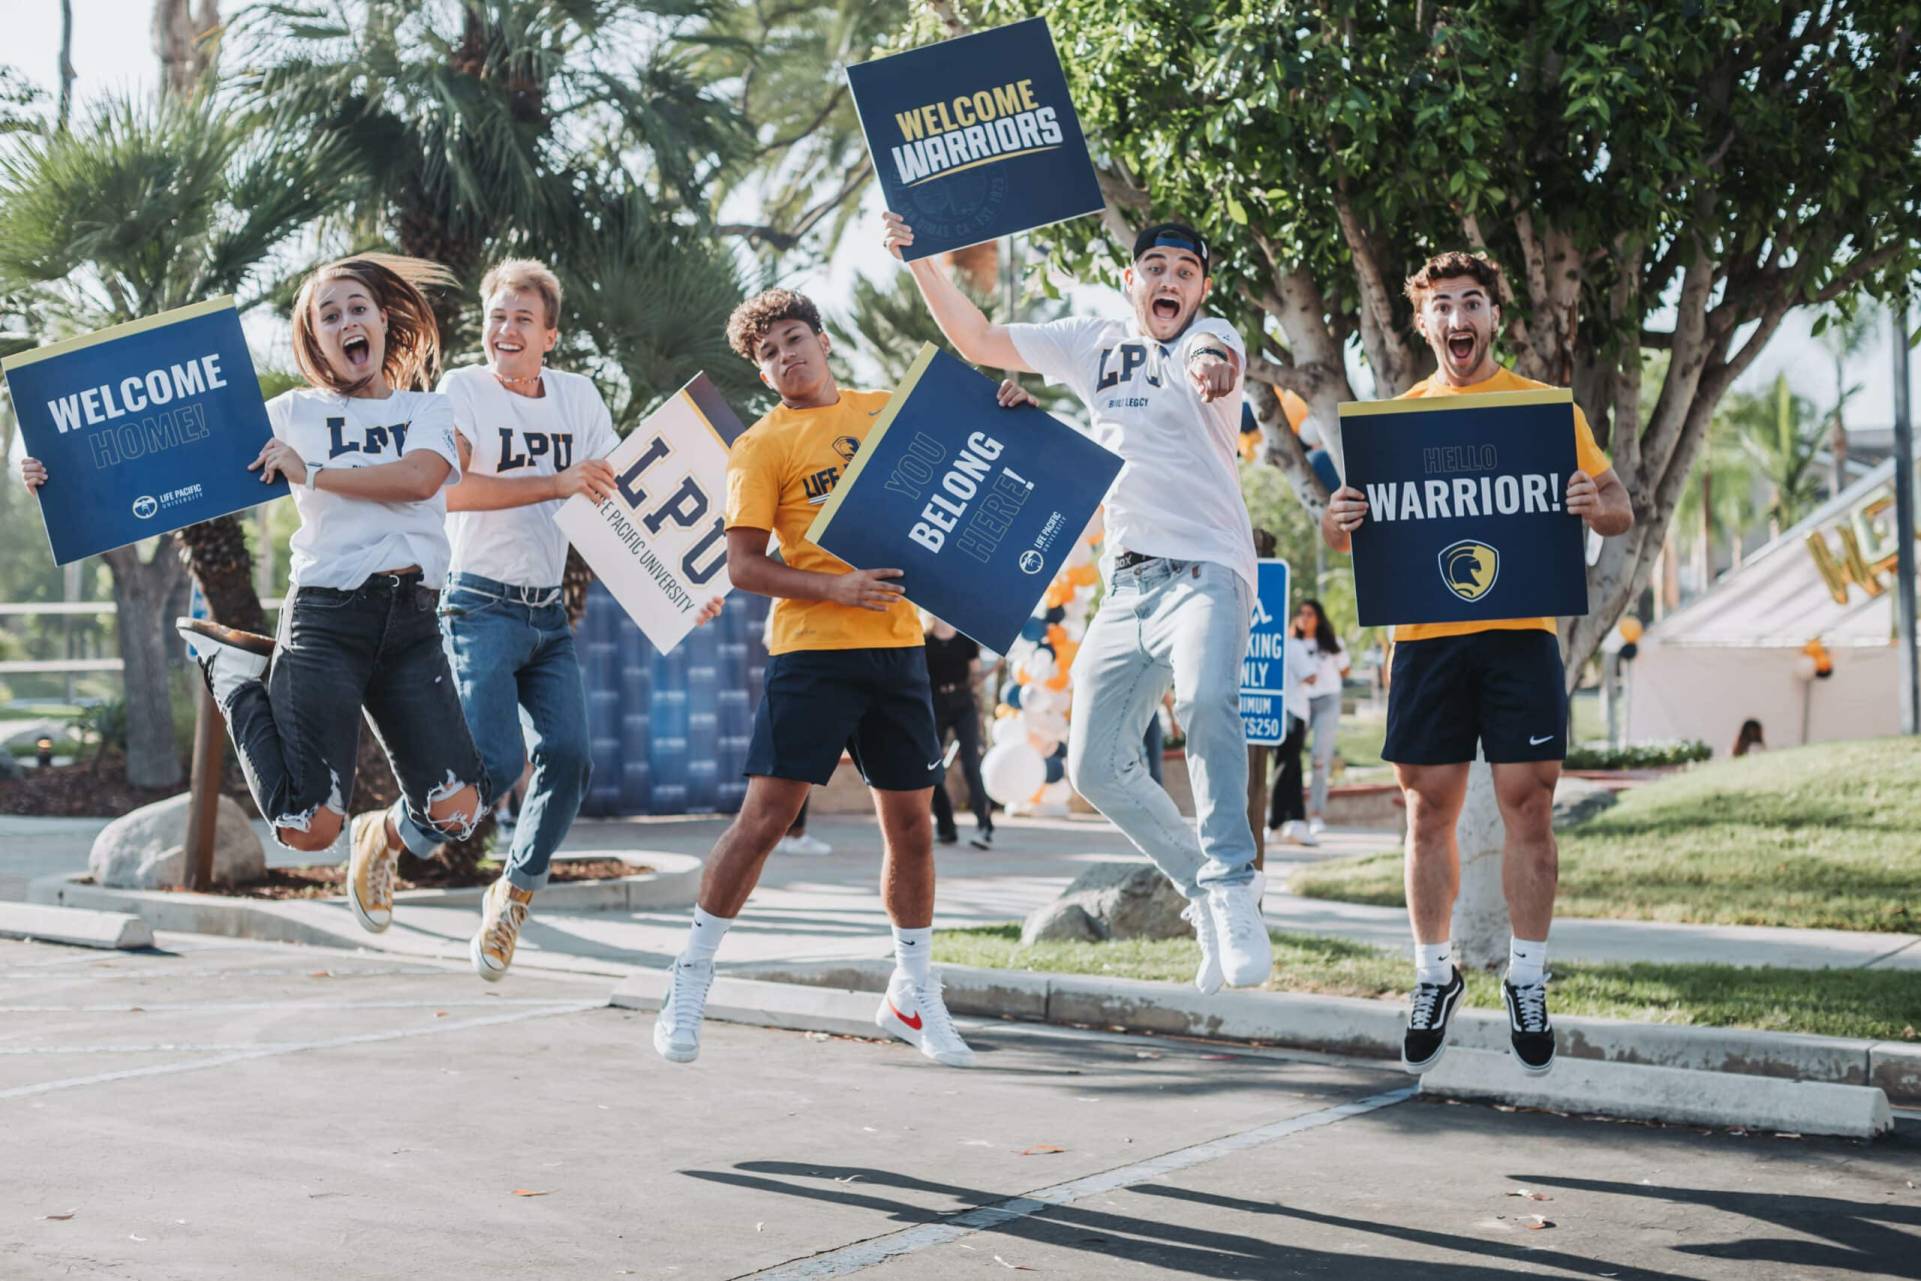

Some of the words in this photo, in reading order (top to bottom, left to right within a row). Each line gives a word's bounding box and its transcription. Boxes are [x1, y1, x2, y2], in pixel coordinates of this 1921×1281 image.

[895, 79, 1039, 142] WELCOME
[891, 106, 1063, 184] WARRIORS
[47, 353, 228, 434] WELCOME
[88, 403, 210, 469] HOME!
[496, 427, 573, 473] LPU
[884, 431, 946, 500] YOU
[1423, 443, 1498, 474] HELLO
[159, 491, 174, 503] LIFE
[174, 483, 202, 497] PACIFIC
[614, 436, 728, 585] LPU
[908, 431, 1004, 554] BELONG
[956, 467, 1035, 564] HERE!
[1366, 473, 1561, 522] WARRIOR!
[1034, 534, 1047, 549] LIFE
[1041, 511, 1061, 536] PACIFIC
[607, 510, 645, 556] PACIFIC
[640, 549, 697, 614] UNIVERSITY
[1240, 662, 1269, 687] NLY
[1247, 633, 1282, 659] KING
[1240, 696, 1271, 714] IMUM
